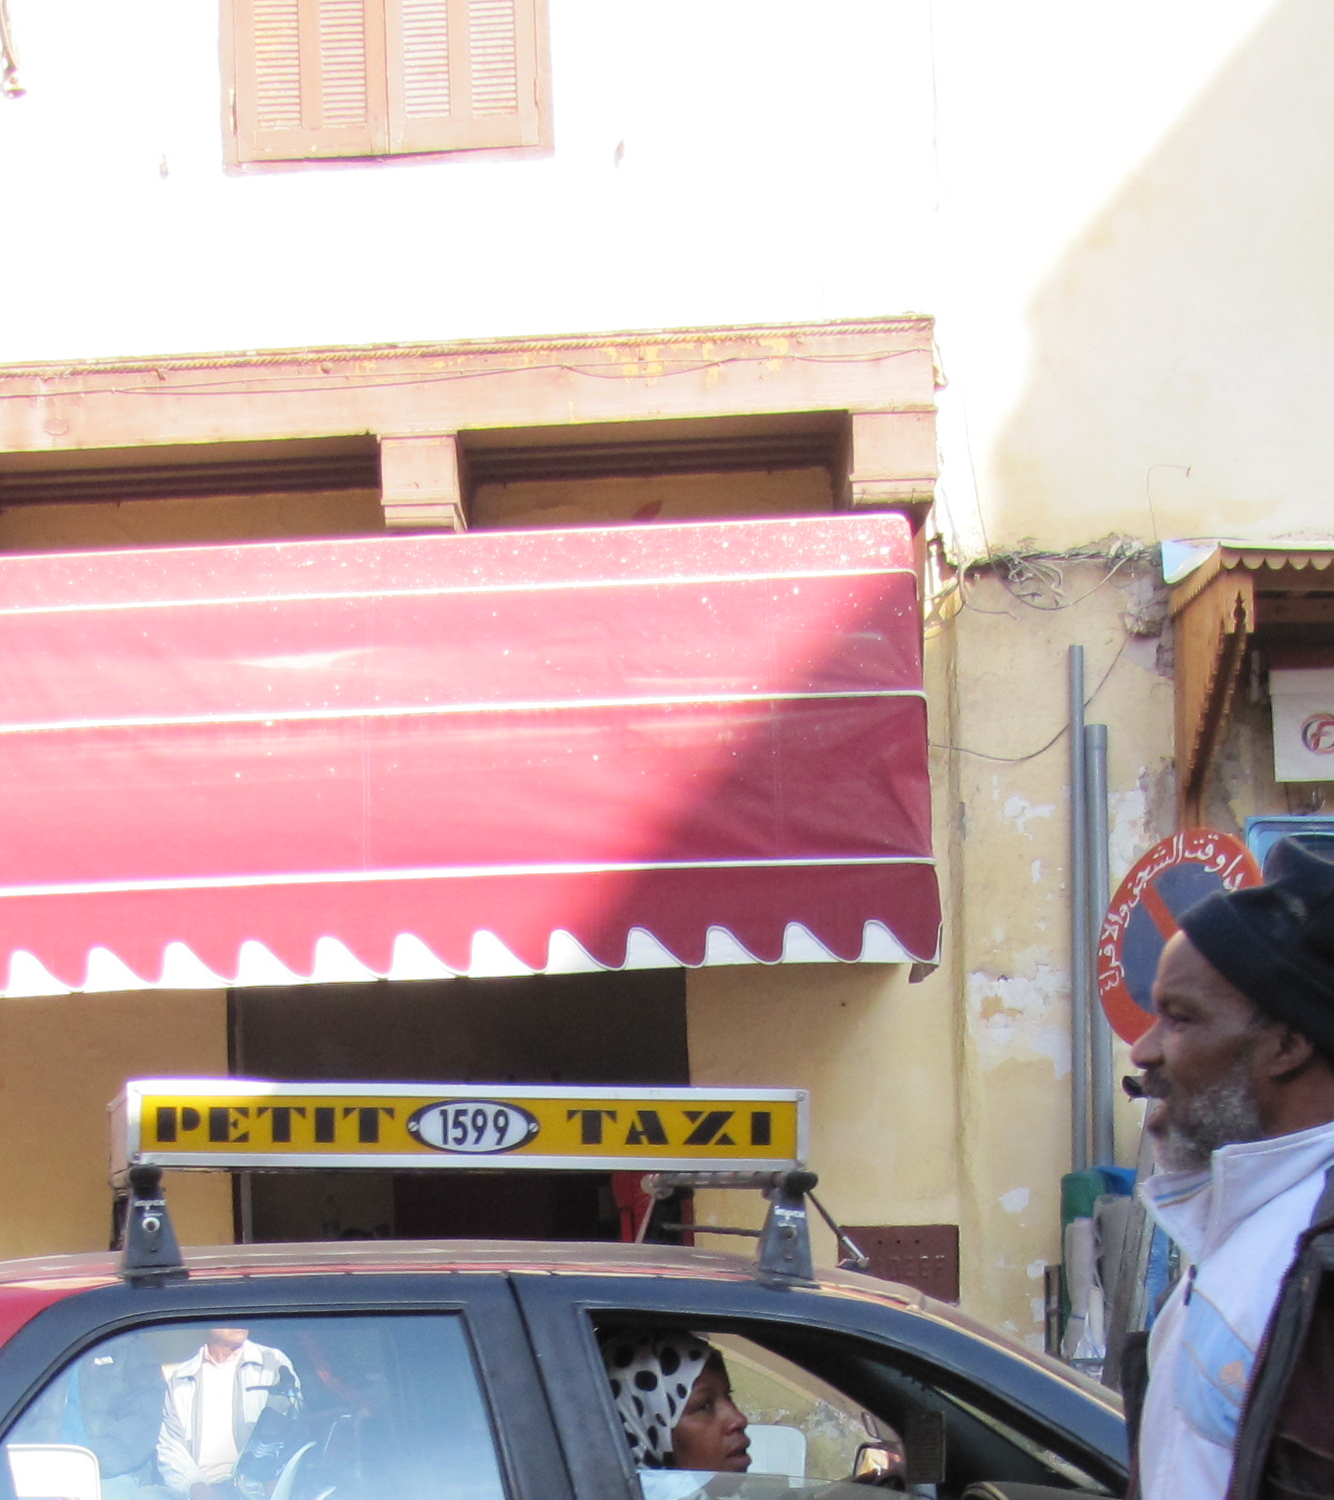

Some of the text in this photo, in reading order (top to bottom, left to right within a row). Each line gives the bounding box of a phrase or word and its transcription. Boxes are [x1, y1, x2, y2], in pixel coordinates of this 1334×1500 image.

[156, 1106, 772, 1147] PETIT 1599 TAXI
